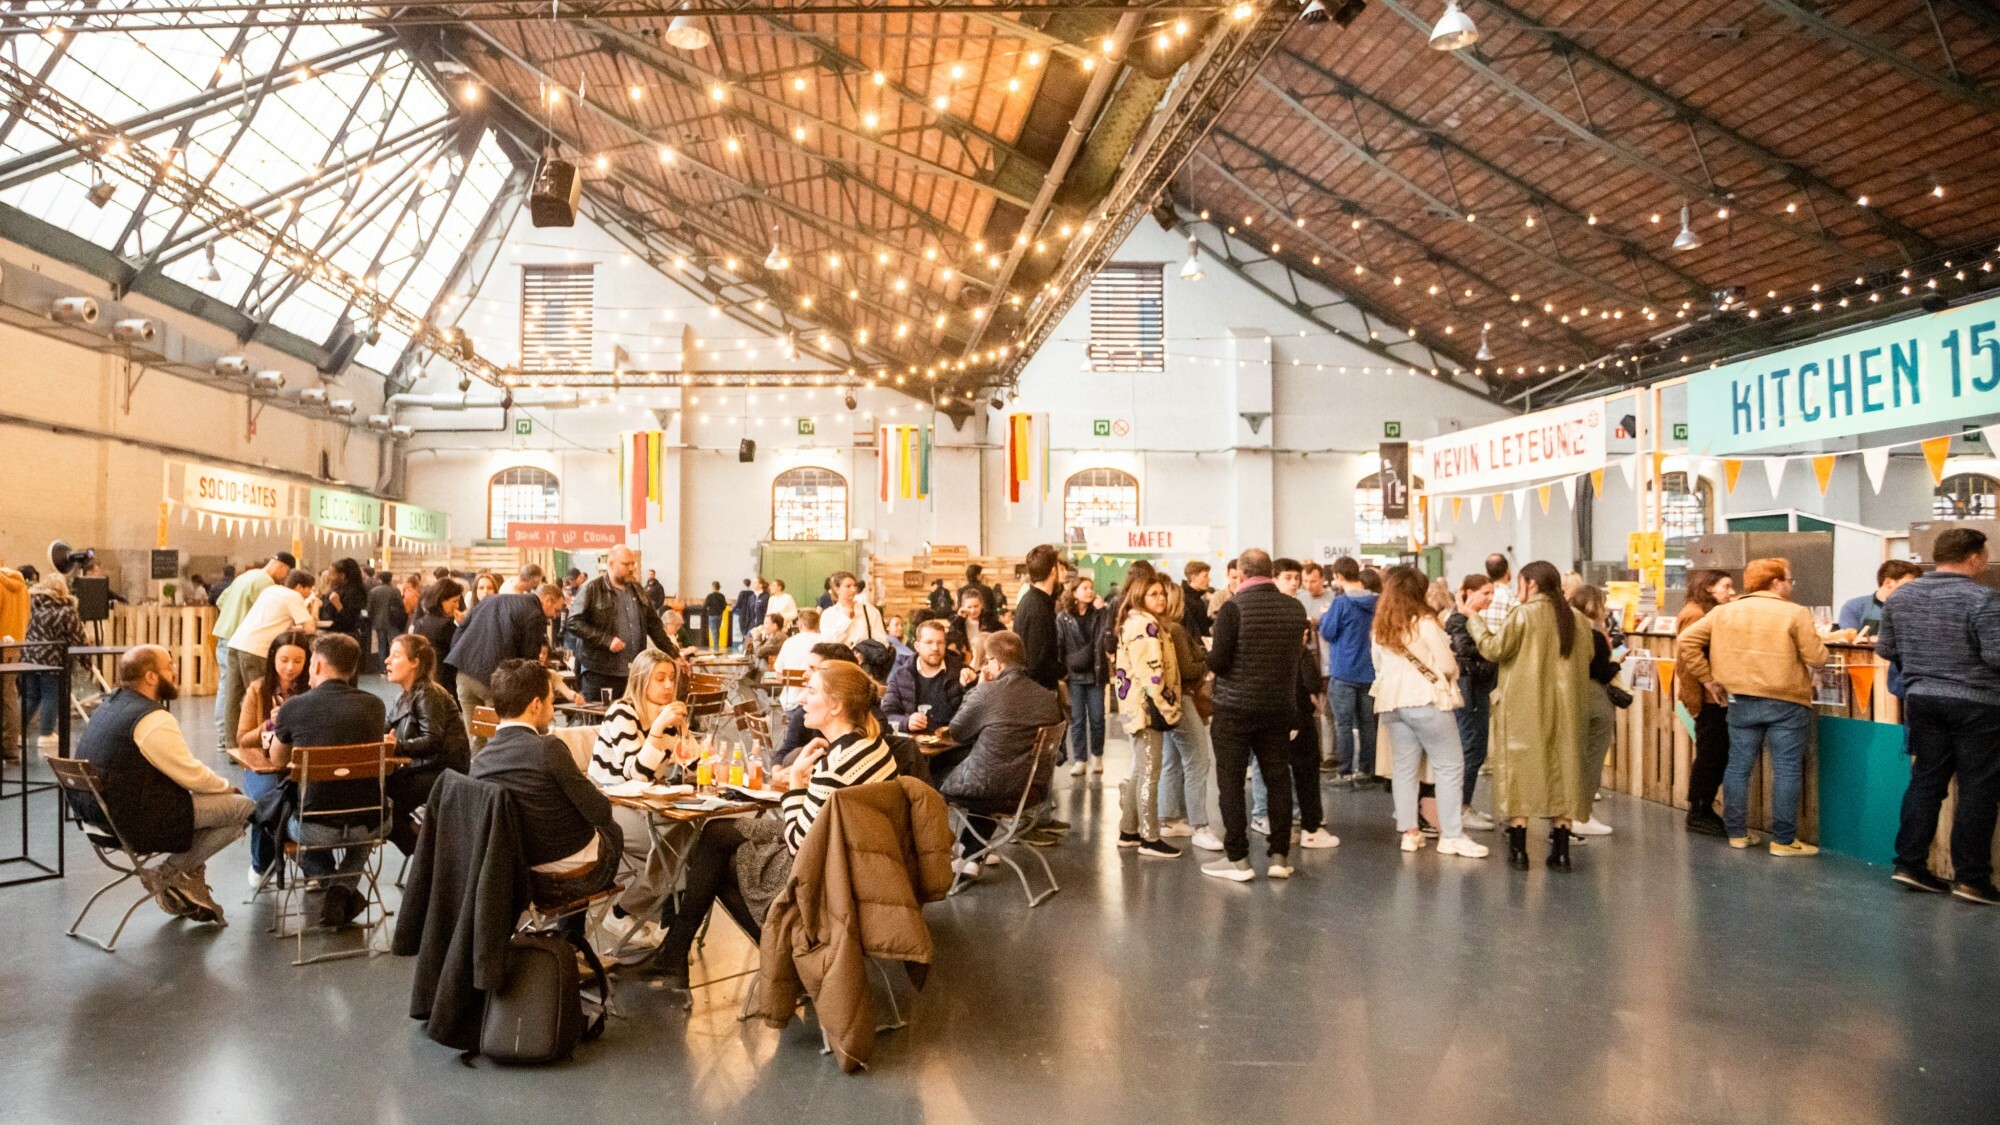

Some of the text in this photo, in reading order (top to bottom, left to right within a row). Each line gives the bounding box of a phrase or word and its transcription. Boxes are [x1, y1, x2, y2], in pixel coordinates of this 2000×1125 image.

[1731, 320, 2000, 435] KITCHEN 15
[1433, 442, 1480, 481] KEVIN
[546, 530, 557, 544] IT
[563, 530, 577, 544] UP
